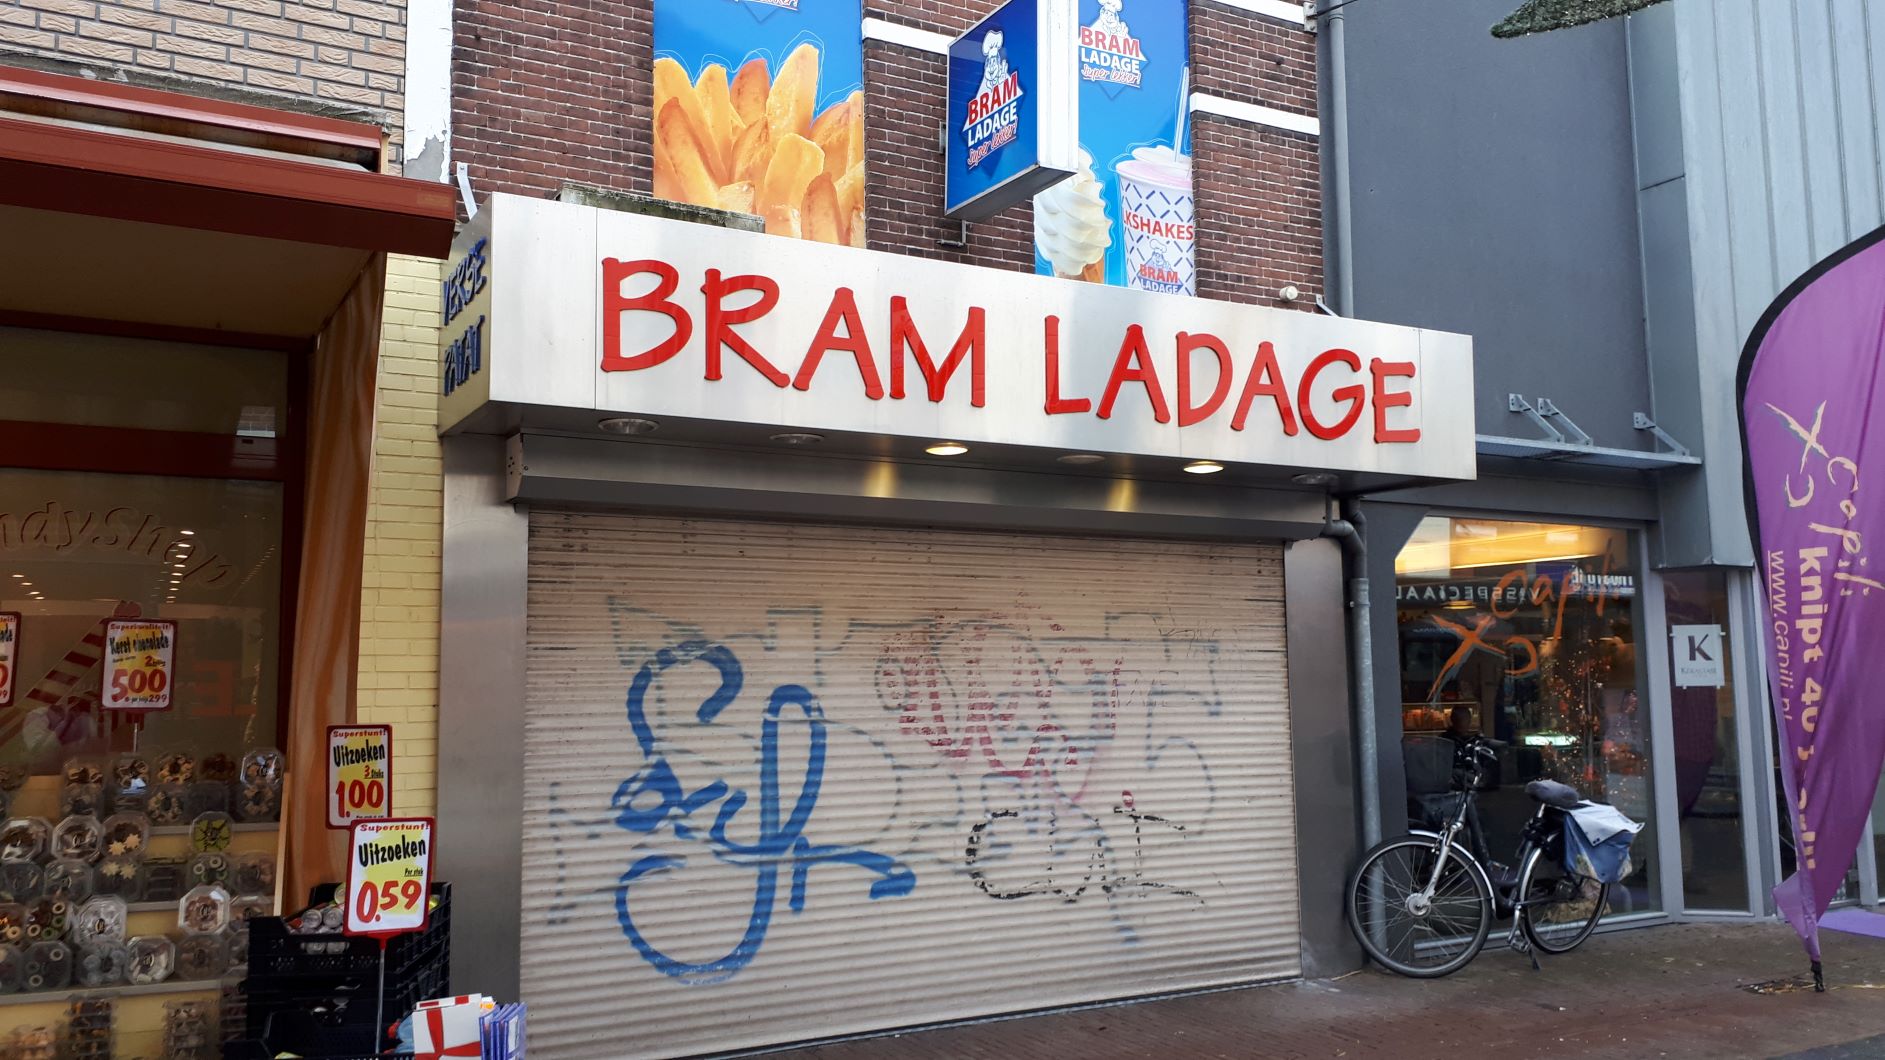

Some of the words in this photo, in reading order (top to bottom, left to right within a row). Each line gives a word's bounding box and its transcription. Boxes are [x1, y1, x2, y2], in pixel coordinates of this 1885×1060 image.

[1081, 27, 1140, 58] BRAM
[1081, 47, 1140, 74] LADAGE
[968, 72, 1018, 126] BRAM
[967, 101, 1018, 148] LADAGE
[1139, 263, 1179, 284] BRAM
[1140, 278, 1179, 296] LADAGE
[600, 257, 985, 408] BRAM
[1044, 315, 1421, 445] LADAGE
[1795, 547, 1829, 664] knipt
[1688, 633, 1714, 661] K
[332, 729, 387, 739] Superstunt!
[333, 739, 386, 768] Uitzoeken
[359, 823, 429, 833] Superstunt!
[358, 834, 426, 868] Uitzoeken
[356, 880, 422, 923] 0.59
